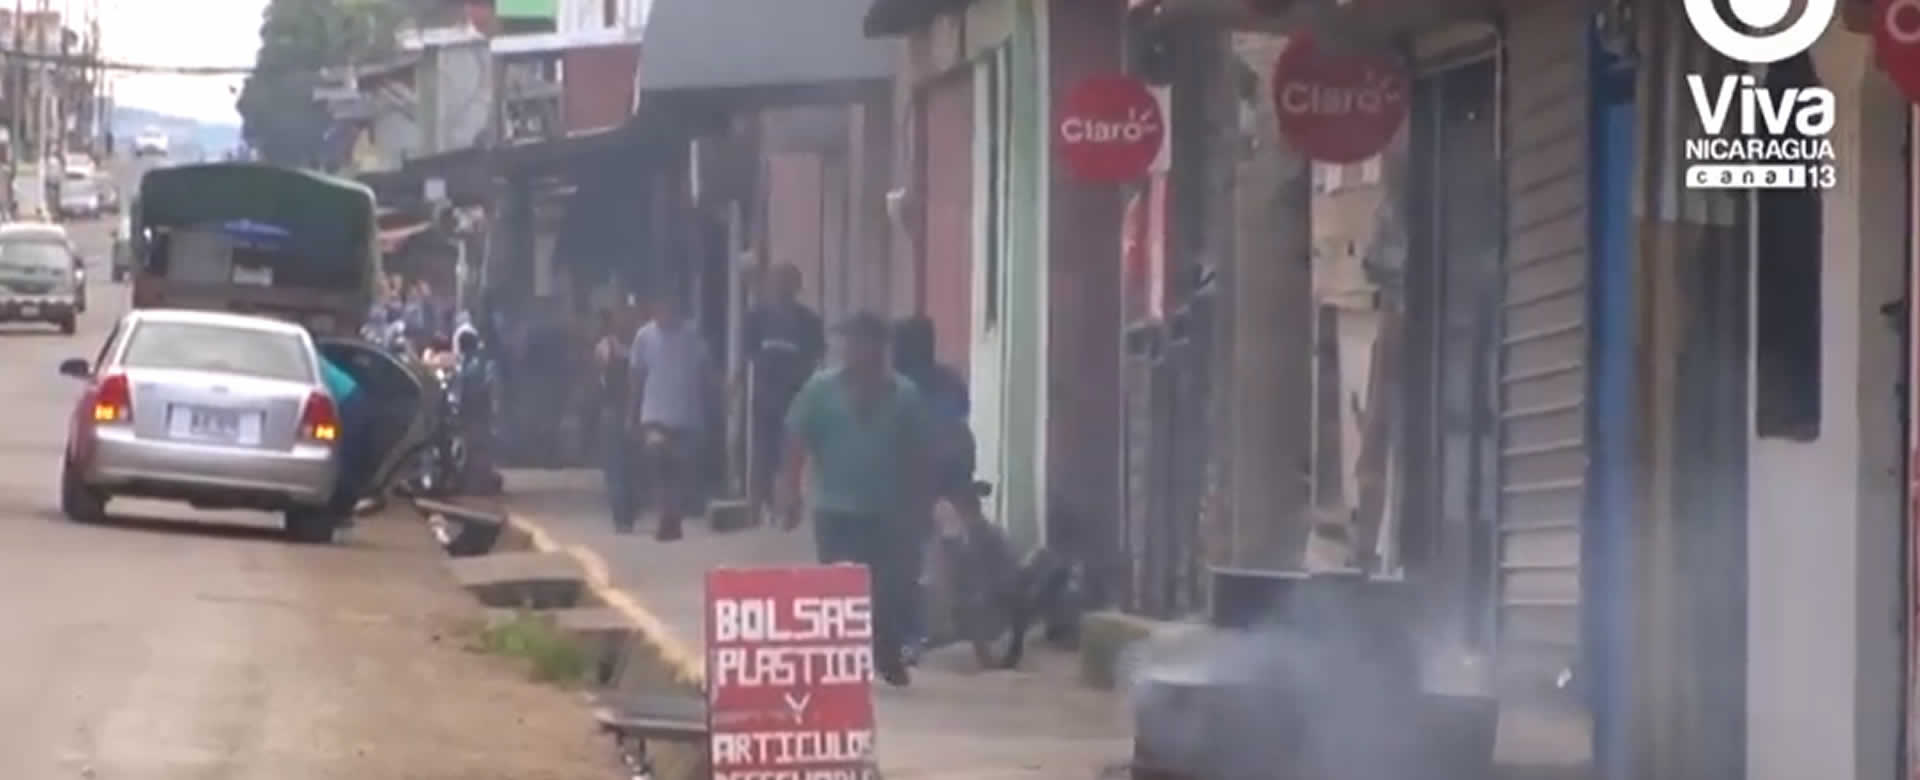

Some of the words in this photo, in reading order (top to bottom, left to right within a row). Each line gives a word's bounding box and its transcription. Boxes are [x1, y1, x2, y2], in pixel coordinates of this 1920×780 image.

[1281, 78, 1388, 115] Claro
[1061, 112, 1146, 143] Claro
[715, 597, 872, 642] BOLSAS
[717, 646, 874, 687] PLASTICA
[784, 692, 811, 725] Y
